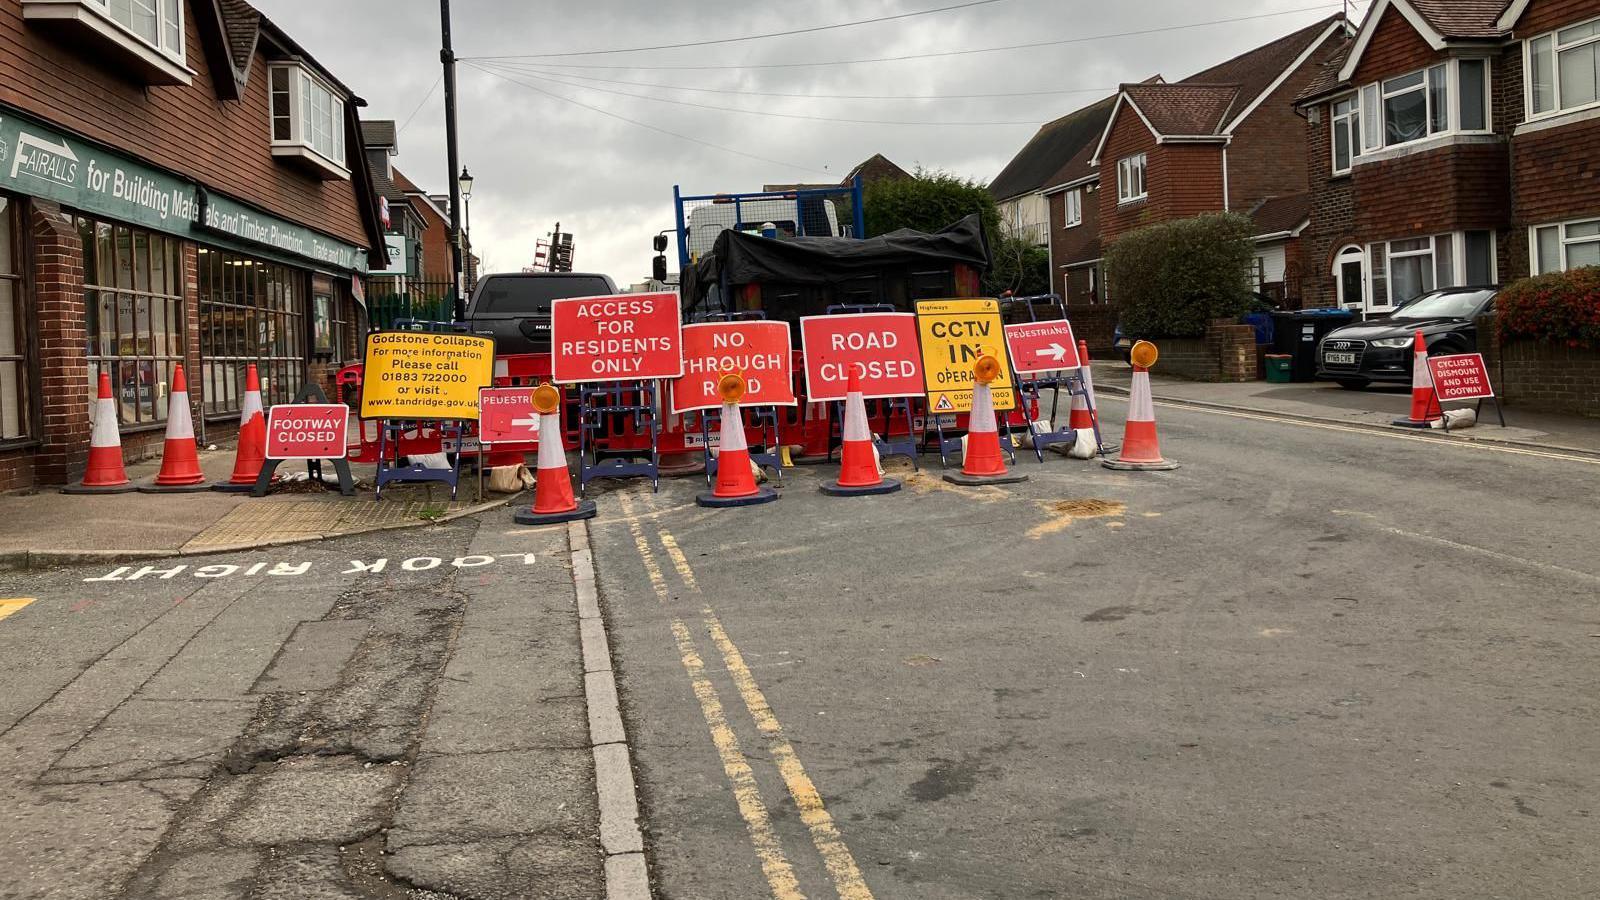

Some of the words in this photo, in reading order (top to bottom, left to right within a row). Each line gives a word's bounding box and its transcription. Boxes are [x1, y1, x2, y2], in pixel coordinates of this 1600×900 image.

[10, 131, 79, 183] FAIRALLS
[87, 160, 110, 192] for
[112, 168, 169, 219] Building
[171, 190, 218, 228] Mateals
[220, 212, 239, 235] and
[576, 301, 654, 318] ACCESS
[597, 320, 634, 335] FOR
[931, 321, 991, 339] CCTV
[1008, 327, 1069, 339] PEDESTRIANS
[372, 335, 429, 344] Godstone
[433, 336, 485, 347] Collapse
[713, 332, 745, 348] NO
[831, 331, 898, 351] ROAD
[562, 337, 671, 356] RESIDENTS
[373, 348, 390, 356] For
[421, 348, 482, 360] information
[949, 344, 981, 363] IN
[392, 359, 432, 370] Please
[436, 361, 458, 370] call
[591, 357, 643, 374] ONLY
[1437, 359, 1474, 368] CYCLISTS
[382, 372, 418, 381] 01883
[422, 374, 467, 382] 722000
[820, 360, 915, 382] CLOSED
[1437, 368, 1480, 378] DISMOUNT
[703, 379, 761, 397] RD
[1443, 379, 1461, 387] AND
[1463, 377, 1480, 385] USE
[398, 386, 409, 394] or
[1444, 386, 1483, 396] FOOTWAY
[368, 398, 480, 407] www.tandridge.gov.uk
[483, 396, 530, 405] PEDESTR
[273, 419, 342, 430] FOOTWAY
[278, 431, 336, 443] CLOSED
[342, 552, 537, 575] LOOK
[83, 561, 312, 582] RIGHT
